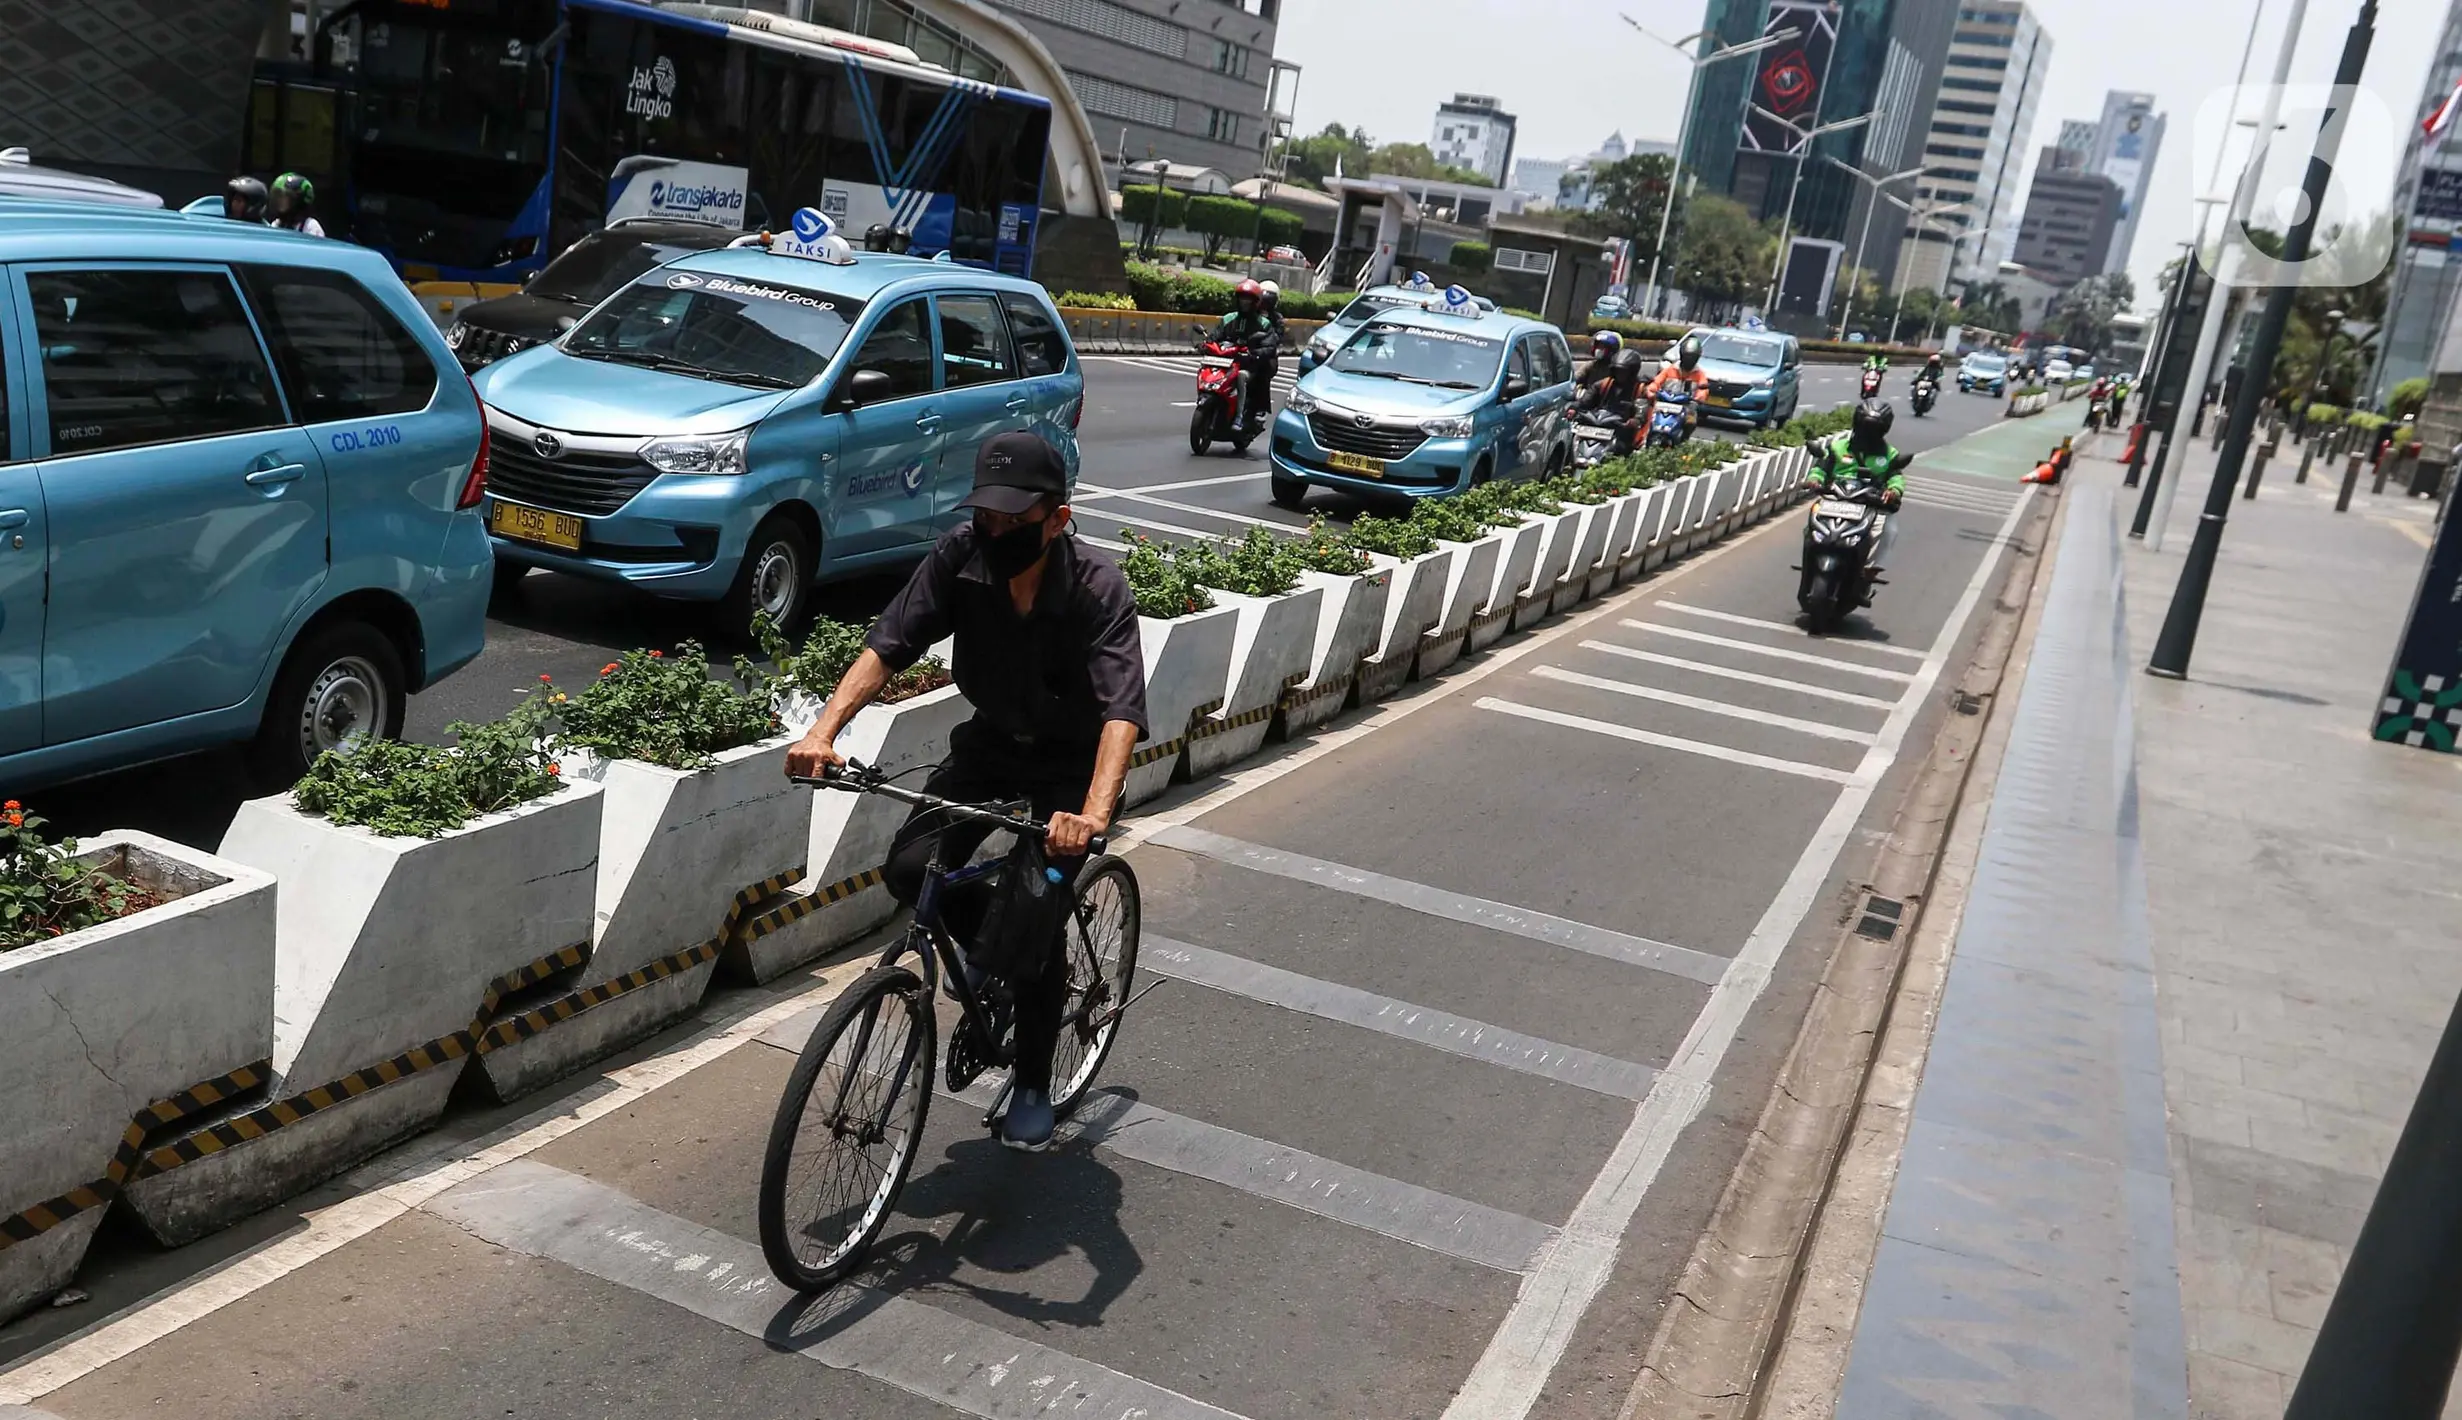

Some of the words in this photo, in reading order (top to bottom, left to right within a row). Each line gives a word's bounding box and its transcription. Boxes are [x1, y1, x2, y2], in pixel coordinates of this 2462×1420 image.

[628, 66, 653, 91] Jak
[626, 89, 671, 121] Lingko
[665, 182, 742, 210] transjakarta
[785, 241, 831, 259] TAKSI
[705, 278, 788, 300] Bluebird
[785, 292, 835, 311] Group
[1440, 304, 1470, 315] TAKSI
[1405, 326, 1458, 341] Bluebird
[1456, 335, 1489, 347] Group
[332, 431, 366, 452] CDL
[365, 425, 401, 448] 2010
[848, 467, 898, 497] Bluebird
[494, 503, 504, 522] B
[515, 507, 547, 531] 1556
